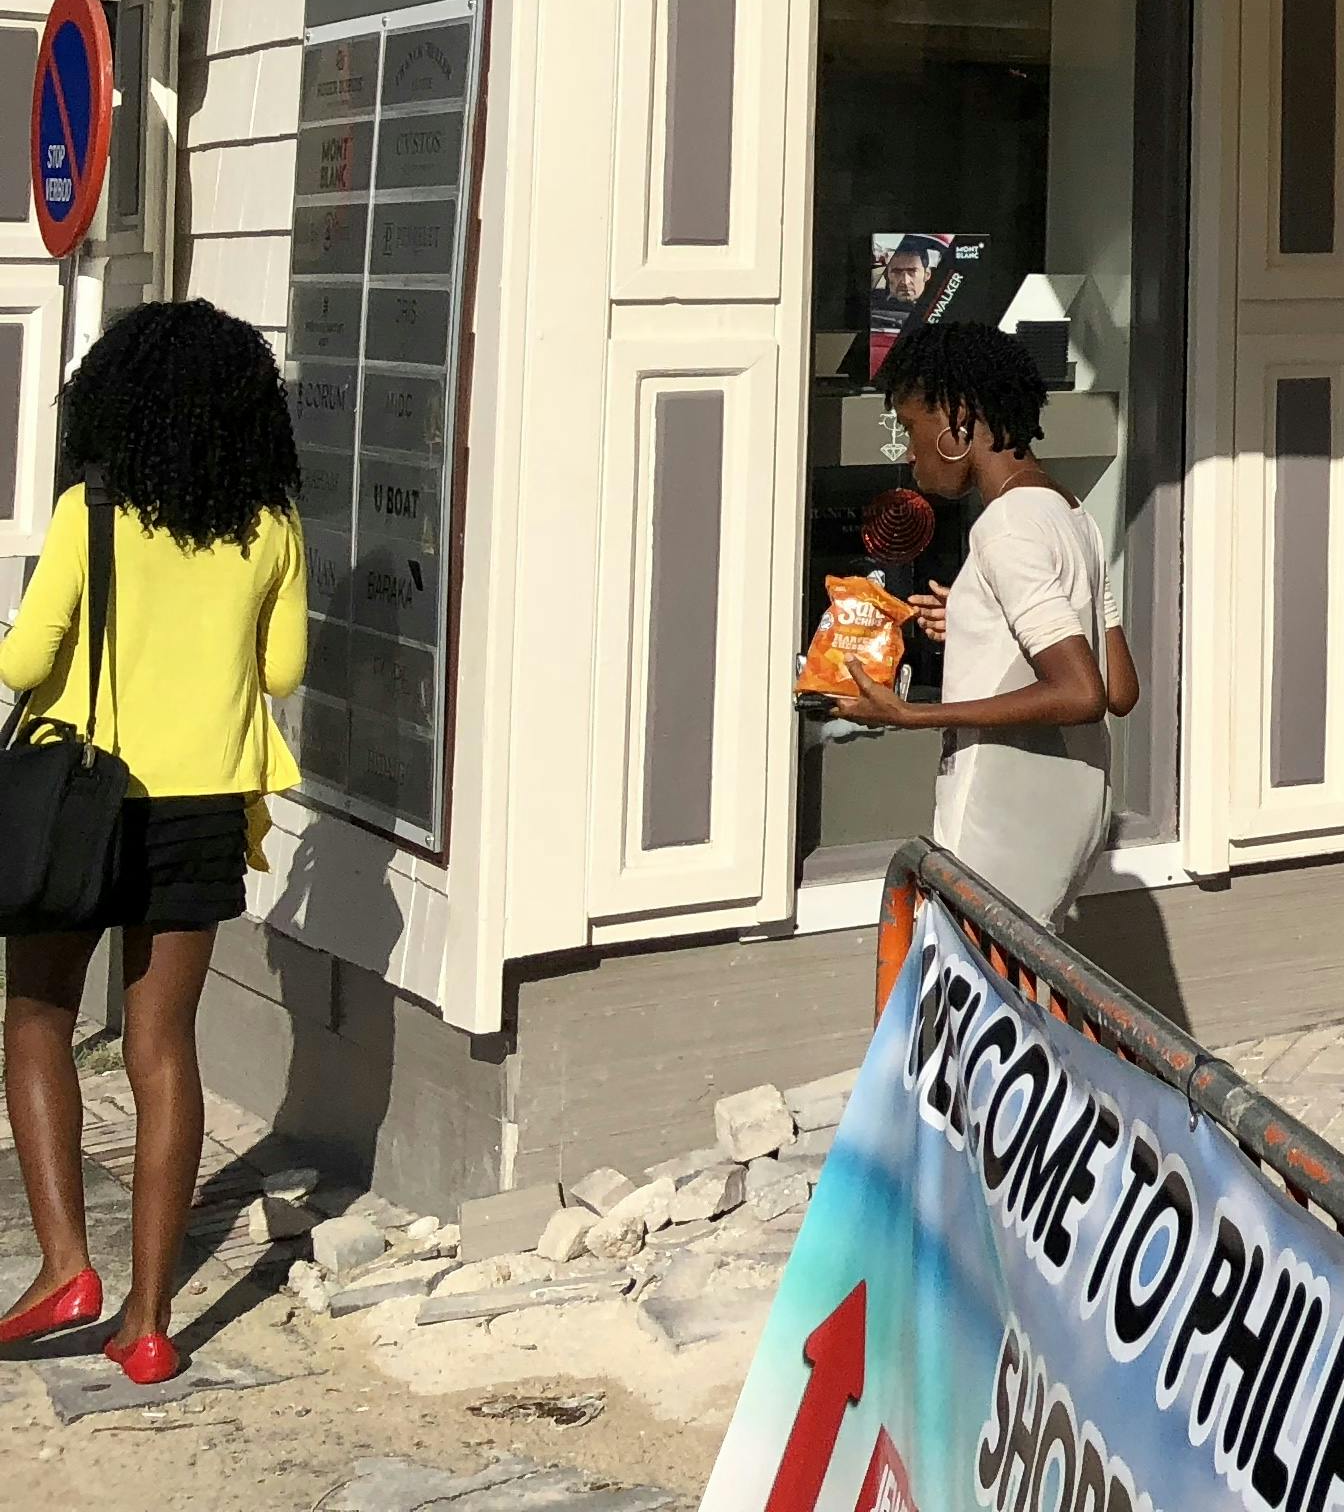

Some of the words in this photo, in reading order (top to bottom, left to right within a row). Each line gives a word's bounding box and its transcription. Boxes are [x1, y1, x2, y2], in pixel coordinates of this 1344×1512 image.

[46, 144, 66, 169] STOP
[955, 245, 980, 254] MONT
[927, 272, 964, 324] EWALKER
[907, 940, 1121, 1270] WELCOME
[1085, 1132, 1194, 1345] TO
